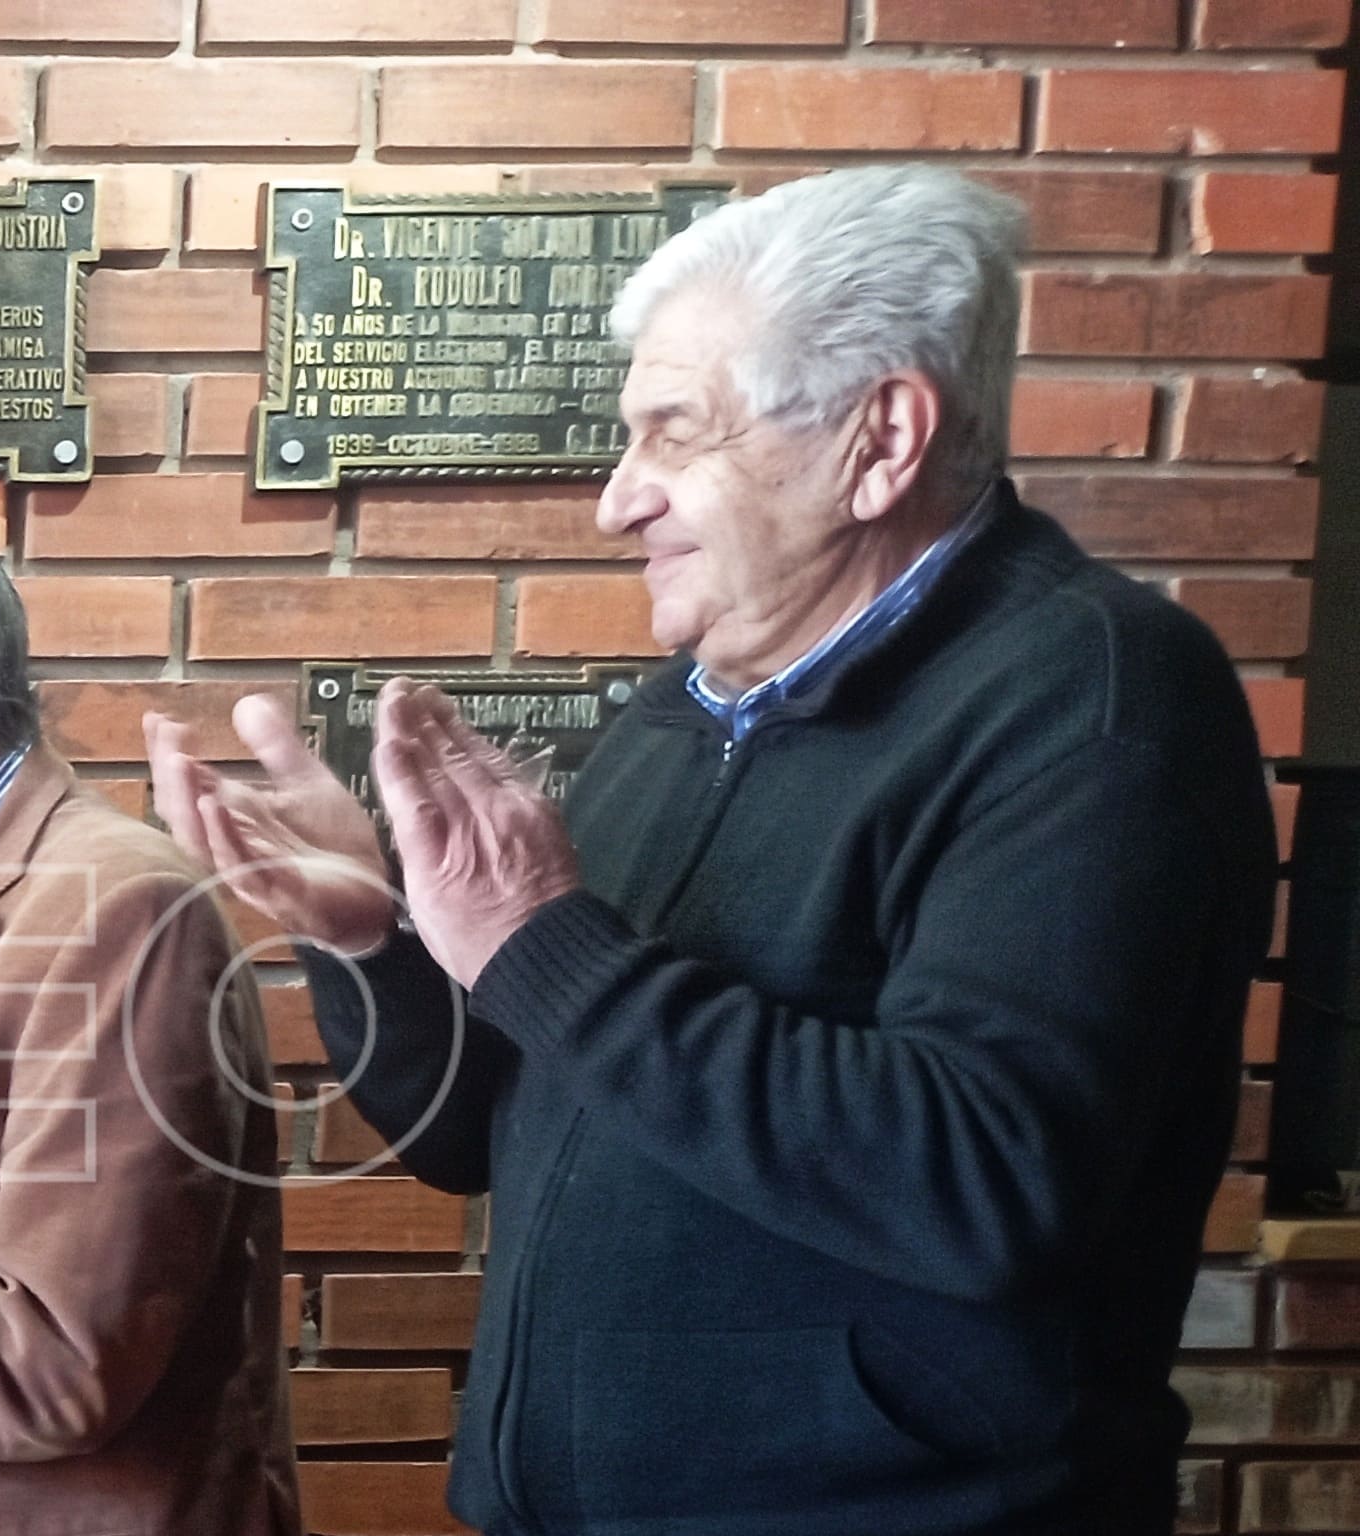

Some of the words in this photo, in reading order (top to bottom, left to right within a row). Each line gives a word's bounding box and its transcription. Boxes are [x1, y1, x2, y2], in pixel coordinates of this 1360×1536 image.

[383, 216, 481, 259] VICENTE
[414, 264, 522, 308] RODOLFO
[294, 313, 306, 336] A
[311, 314, 335, 336] 50
[341, 310, 385, 336] AÑOS
[389, 313, 414, 336] DE
[419, 313, 440, 336] LA
[294, 341, 325, 364] DEL
[333, 341, 407, 364] SERVICIO
[295, 369, 307, 391] A
[316, 368, 393, 391] VUESTRO
[294, 395, 318, 417] EN
[329, 394, 407, 417] OBTENER
[417, 394, 442, 416] LA
